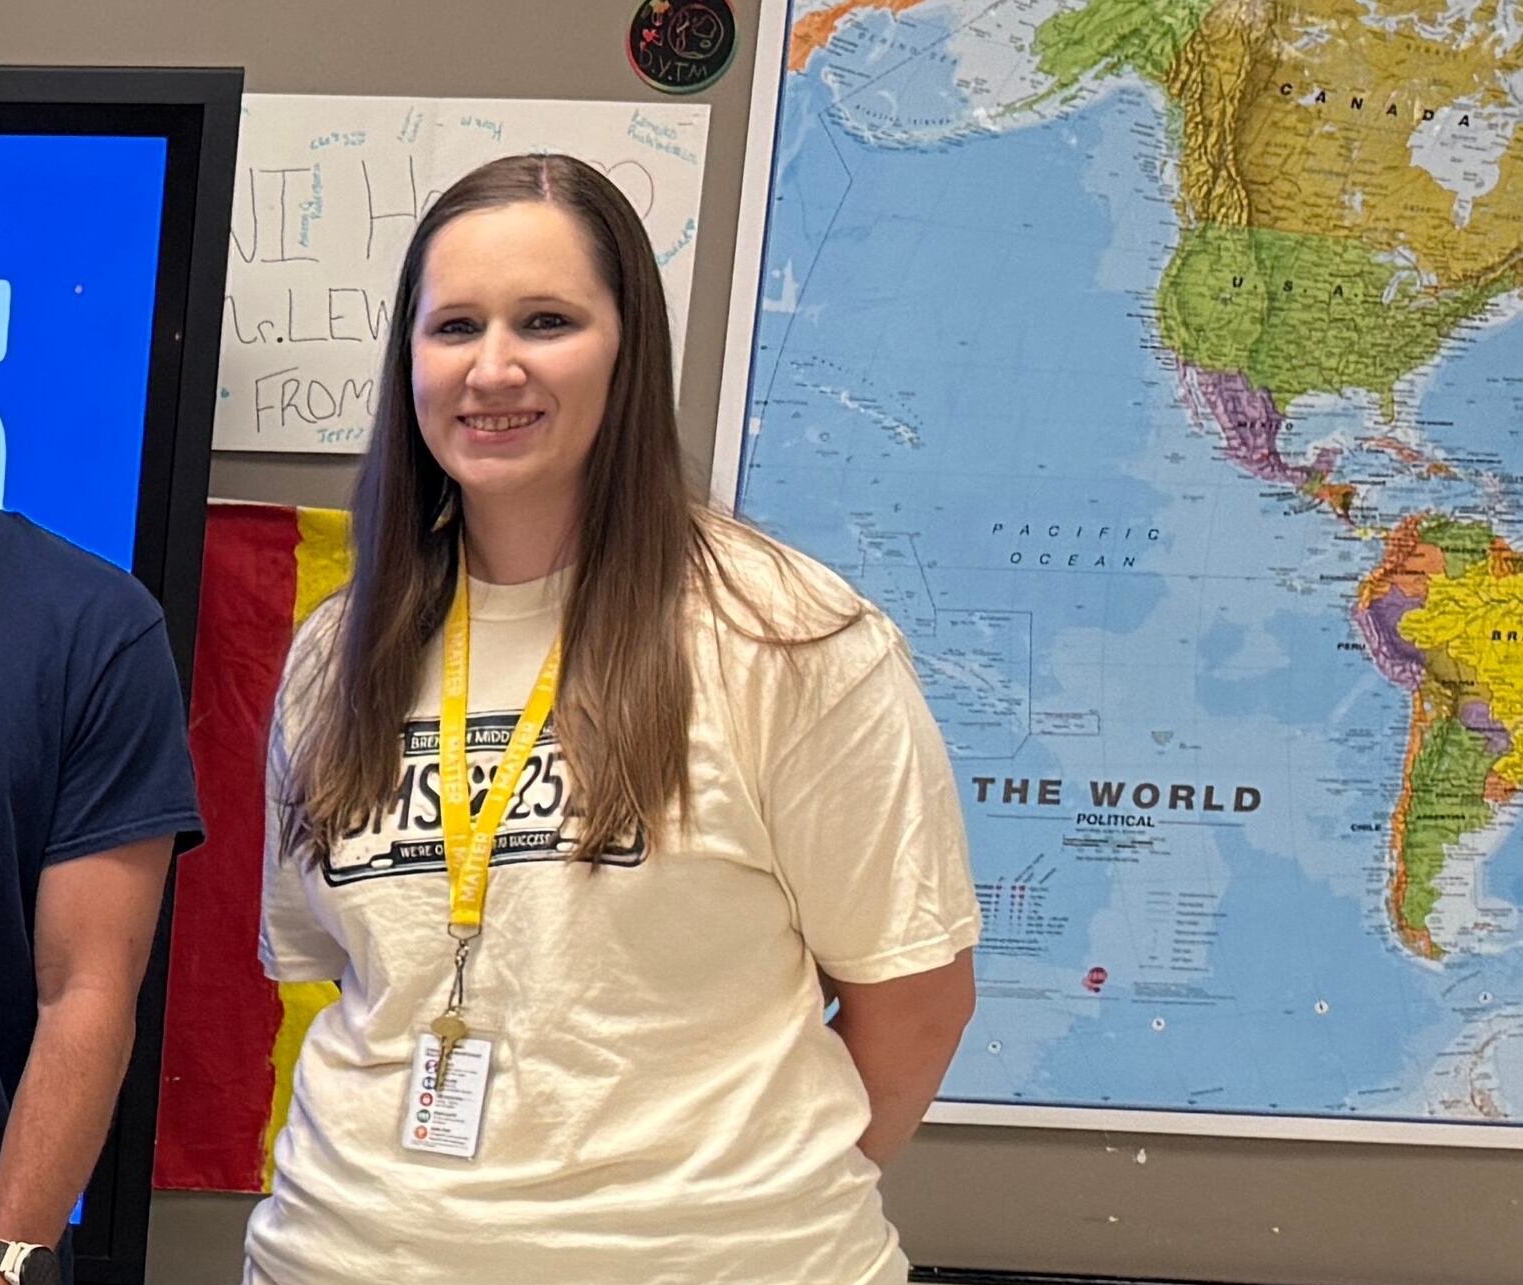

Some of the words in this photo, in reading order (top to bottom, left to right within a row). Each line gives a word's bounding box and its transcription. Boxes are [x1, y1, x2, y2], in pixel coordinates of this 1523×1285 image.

[1279, 82, 1472, 128] CANADA
[255, 366, 375, 434] FROM
[992, 521, 1161, 543] PACIFIC
[1008, 550, 1137, 569] OCEAN
[1337, 642, 1367, 651] PERU
[971, 776, 1063, 806] THE
[1089, 780, 1262, 813] WORLD
[1075, 812, 1156, 829] POLITICAL
